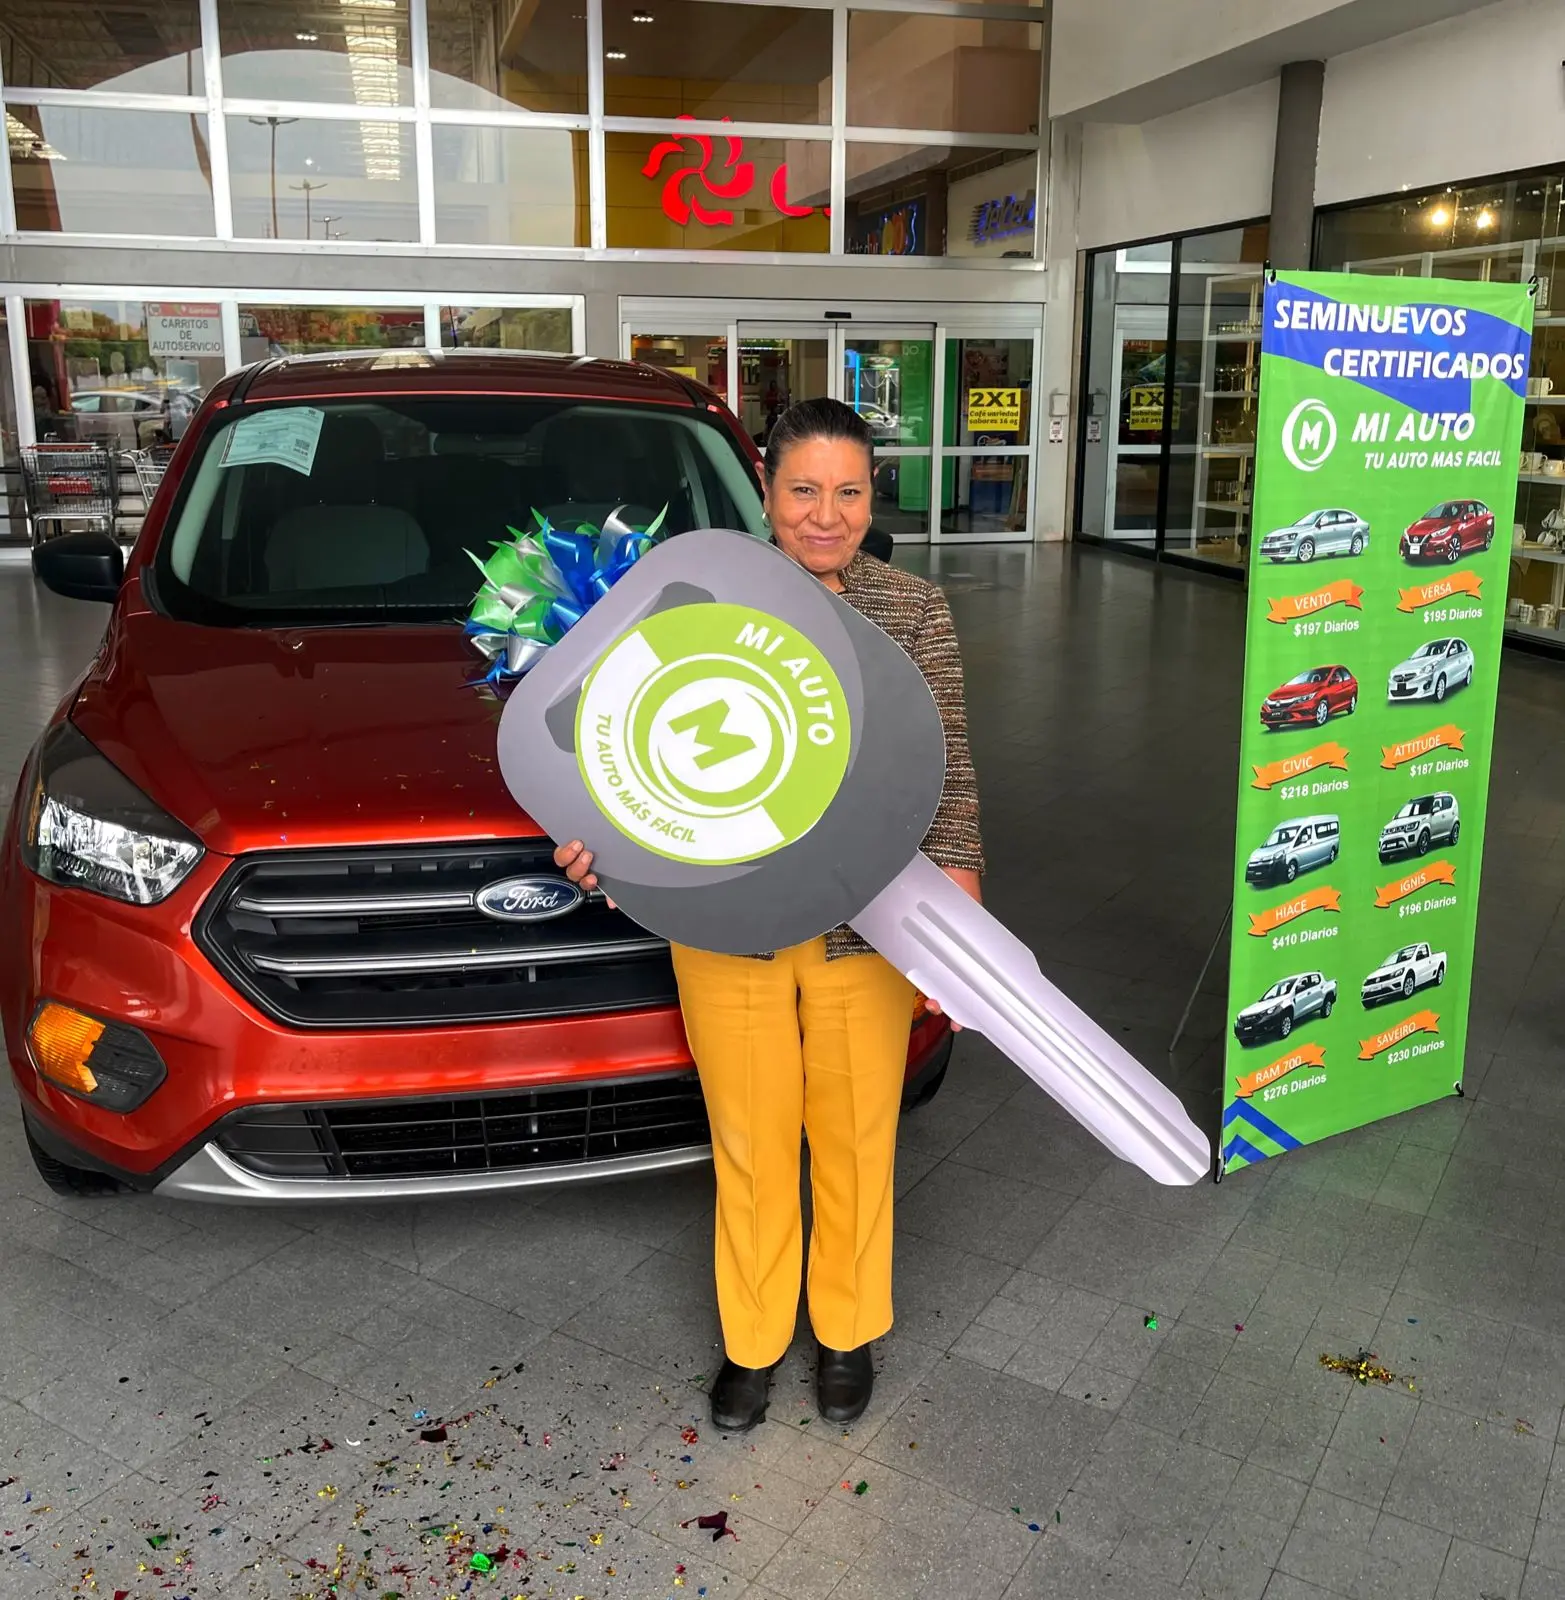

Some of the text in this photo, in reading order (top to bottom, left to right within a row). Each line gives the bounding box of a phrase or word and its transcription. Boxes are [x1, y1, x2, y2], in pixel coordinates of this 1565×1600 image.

[161, 318, 209, 329] CARRITOS
[1274, 300, 1466, 336] SEMINUEVOS
[180, 330, 193, 340] DE
[152, 340, 221, 352] AUTOSERVICIO
[1324, 348, 1524, 379] CERTIFICADOS
[970, 391, 1019, 408] 2X1
[1299, 421, 1322, 450] M
[1352, 413, 1475, 442] MI AUTO
[1365, 451, 1501, 468] TU AUTO MAS FACIL
[1422, 583, 1453, 598] VERSA
[1295, 593, 1333, 610] VENTO
[1423, 607, 1483, 624] $195 Diarios
[1293, 620, 1360, 637] $197 Diarios
[735, 622, 835, 746] MI AUTO
[667, 698, 758, 771] M
[1395, 735, 1440, 756] ATTITUDE
[1283, 756, 1312, 773] CIVIC
[1410, 759, 1469, 777] $187 Diarios
[596, 713, 697, 844] TU AUTO MÁS FÁCIL
[1280, 780, 1349, 800] $218 Diarios
[1400, 873, 1426, 892] IGNIS
[503, 885, 560, 911] Ford
[1399, 896, 1457, 918] $196 Diarios
[1276, 900, 1307, 919] HIACE
[1272, 927, 1338, 950] $410 Diarios
[1378, 1023, 1415, 1046] SAVEIRO
[1387, 1040, 1445, 1065] $230 Diarios
[1255, 1055, 1302, 1083] RAM 700
[1263, 1074, 1327, 1102] $276 Diarios
